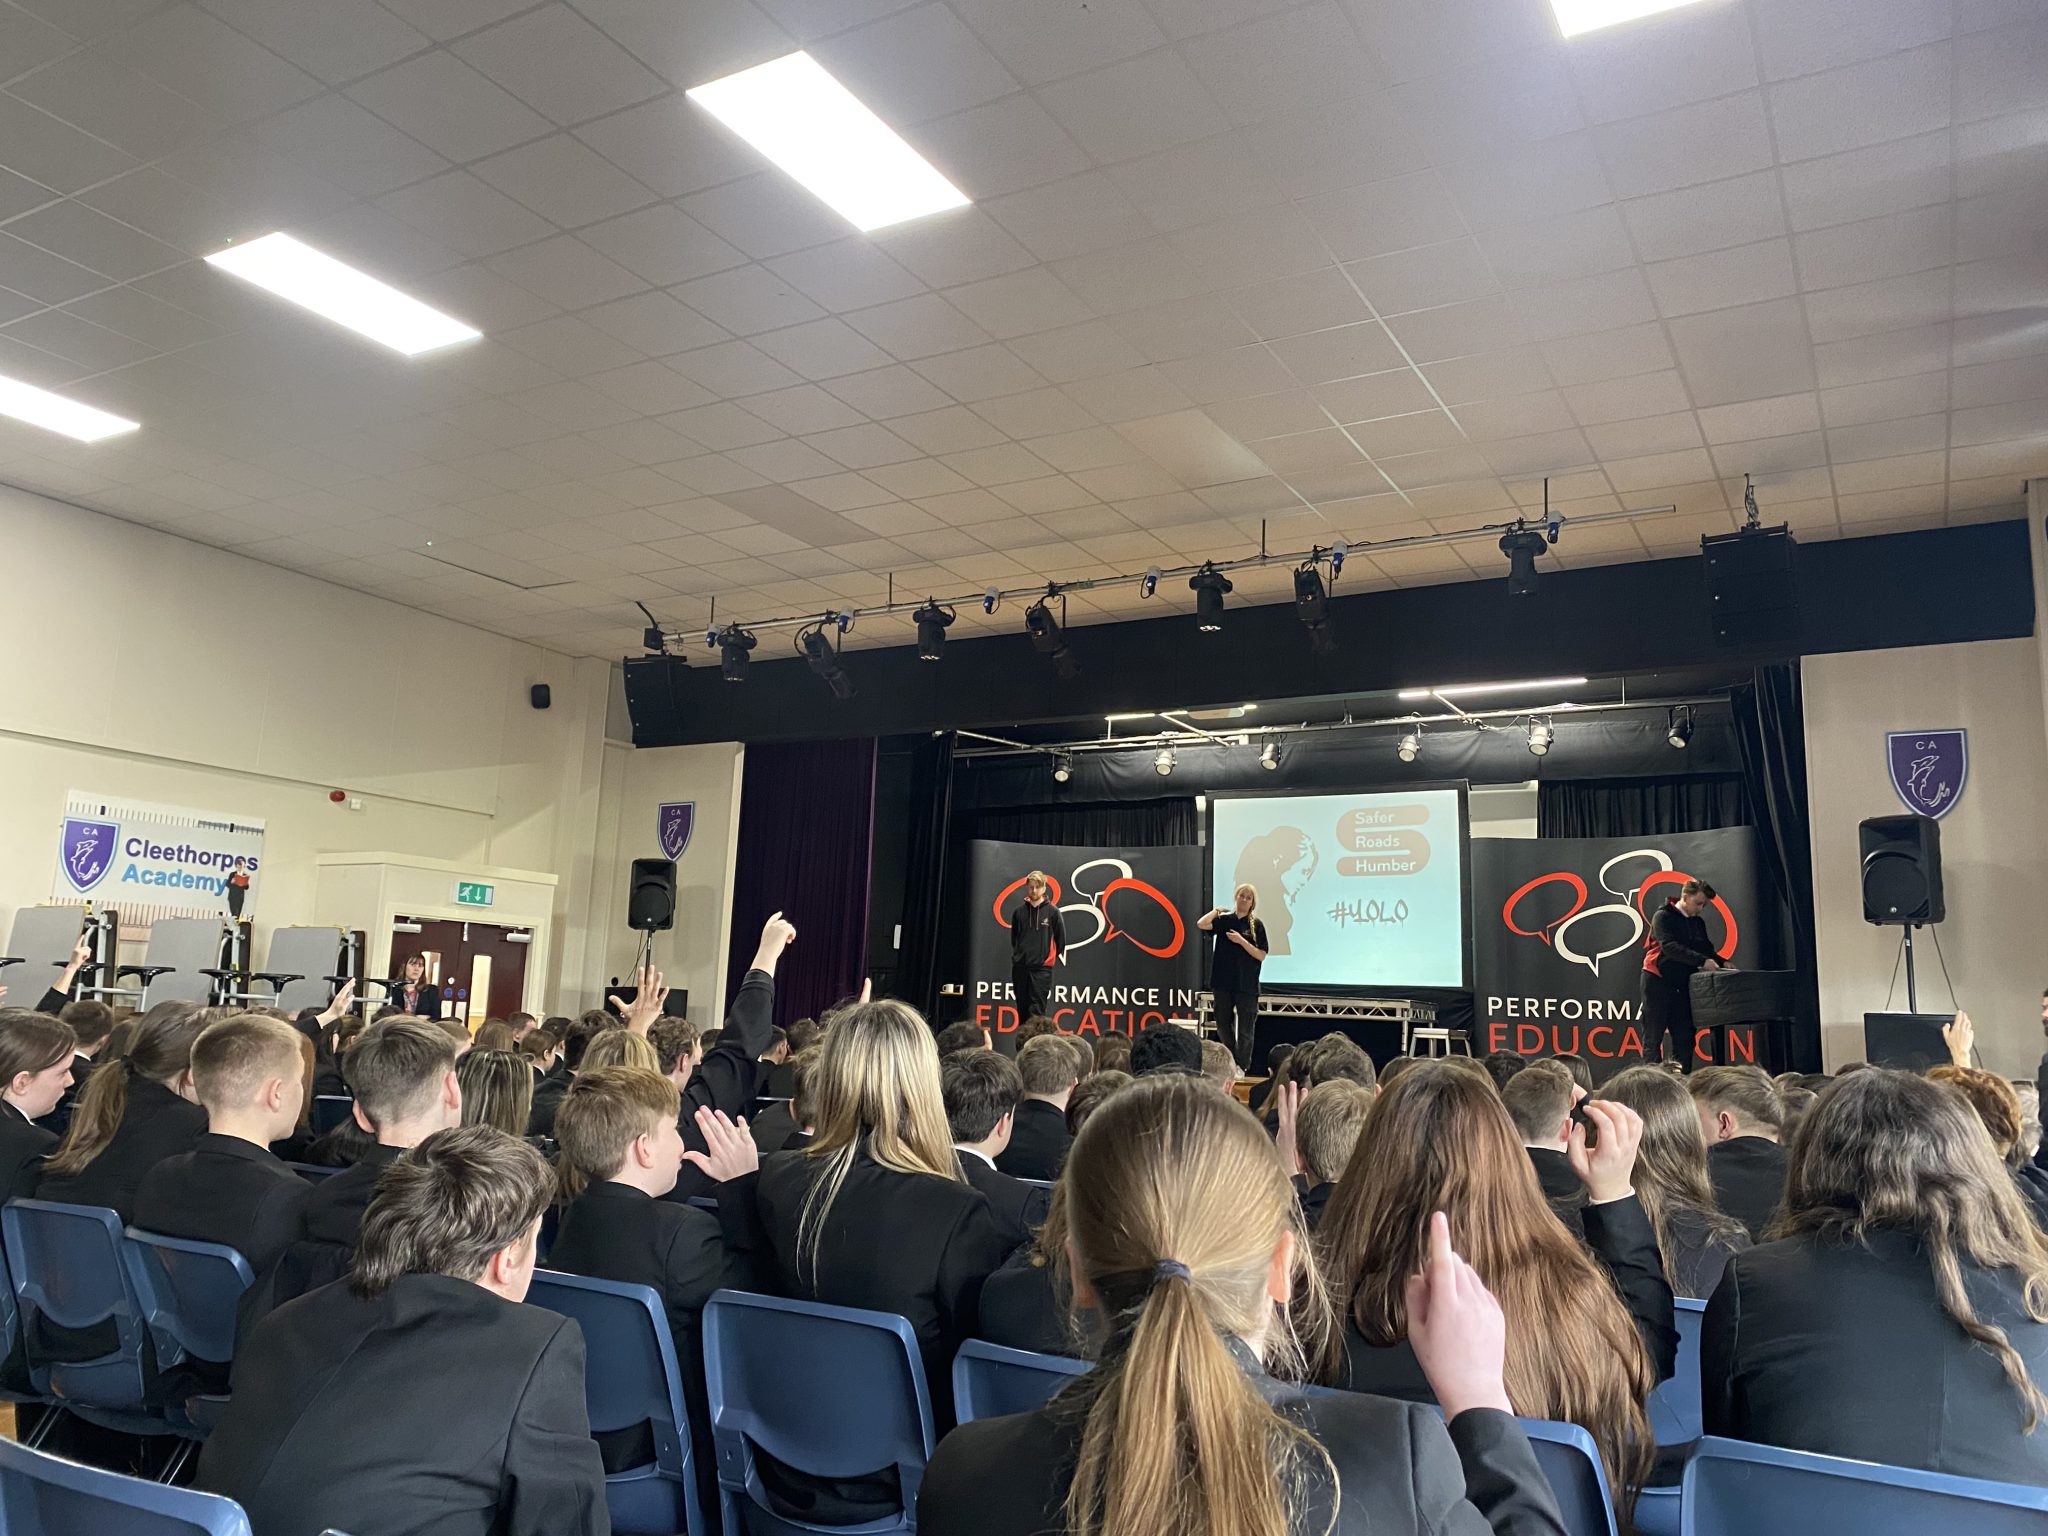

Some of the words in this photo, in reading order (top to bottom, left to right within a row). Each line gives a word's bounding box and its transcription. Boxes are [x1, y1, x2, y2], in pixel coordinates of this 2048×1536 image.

[1355, 810, 1394, 825] Safer
[125, 837, 259, 871] Cleethorpes
[1355, 834, 1401, 849] Roads
[121, 863, 228, 896] Academy
[1355, 858, 1417, 873] Humber
[976, 981, 1159, 1006] PERRMANCE
[1169, 988, 1192, 1008] IN
[976, 1004, 1193, 1038] EDCATIO
[1488, 1023, 1755, 1063] EDUCAON
